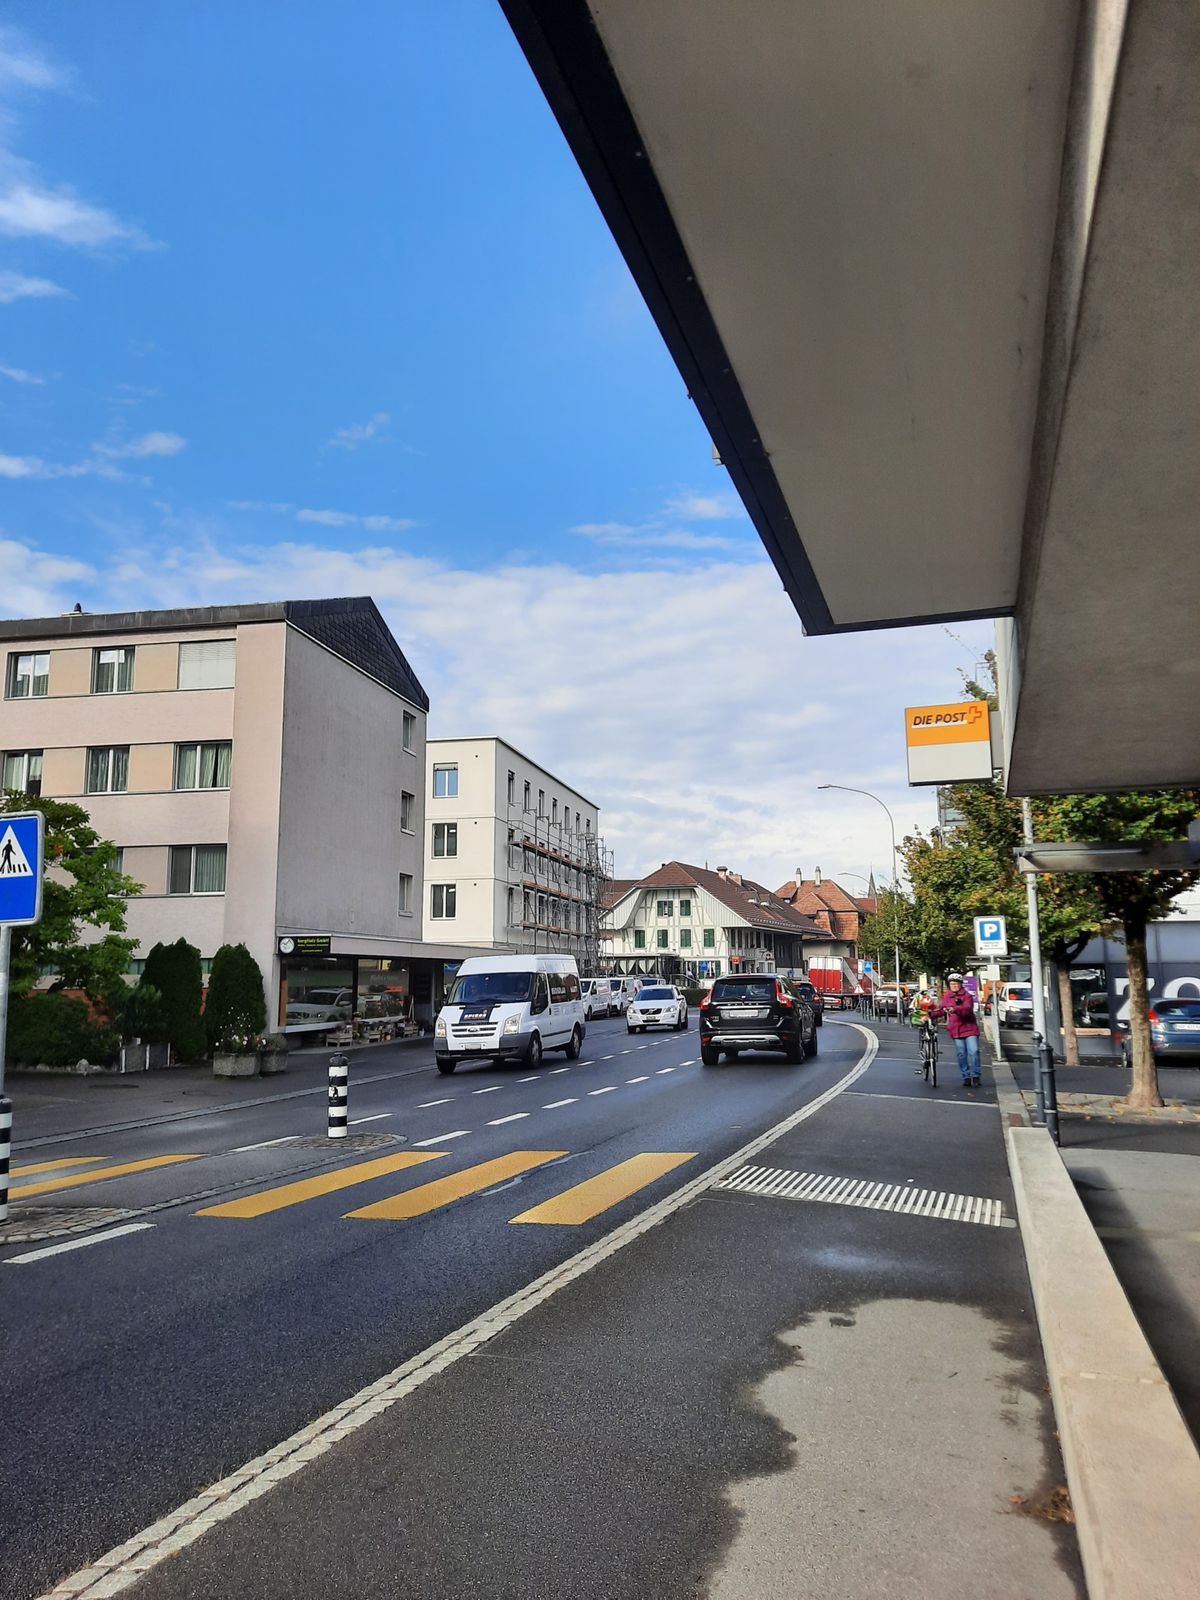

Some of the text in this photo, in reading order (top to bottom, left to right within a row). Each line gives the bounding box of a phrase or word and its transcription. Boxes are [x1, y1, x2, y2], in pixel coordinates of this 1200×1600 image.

[913, 711, 967, 726] DIE POST
[983, 923, 998, 938] P
